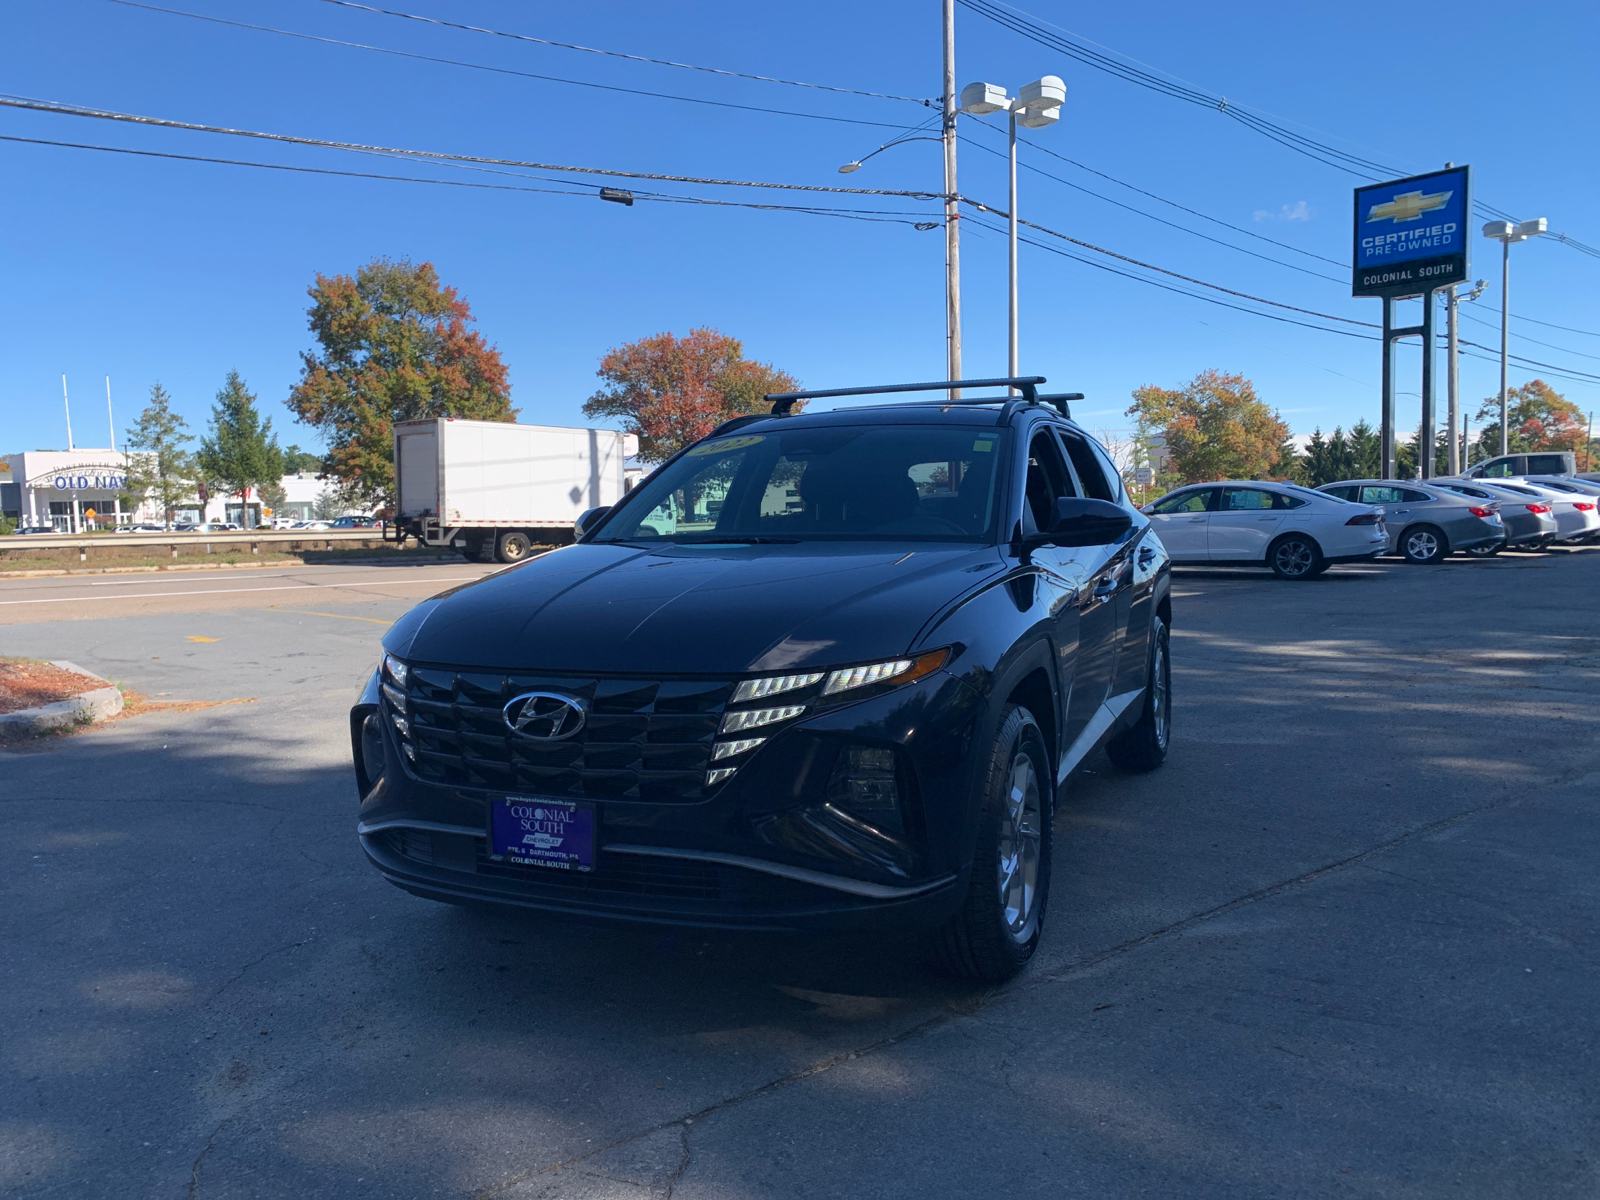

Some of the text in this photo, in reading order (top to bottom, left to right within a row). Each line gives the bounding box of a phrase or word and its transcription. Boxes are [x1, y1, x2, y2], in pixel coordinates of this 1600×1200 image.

[1362, 223, 1456, 246] CERTIFIED
[1366, 234, 1451, 256] PRE-OWNED
[1363, 263, 1453, 285] COLONIAL SOUTH
[55, 475, 129, 490] OLD NAV
[511, 805, 574, 823] COLONIAL
[520, 819, 564, 834] SOUTH
[525, 836, 560, 845] CHEVROLET
[529, 848, 568, 860] DARTMOUTH,
[511, 856, 570, 870] COLONIAL SOUTH
